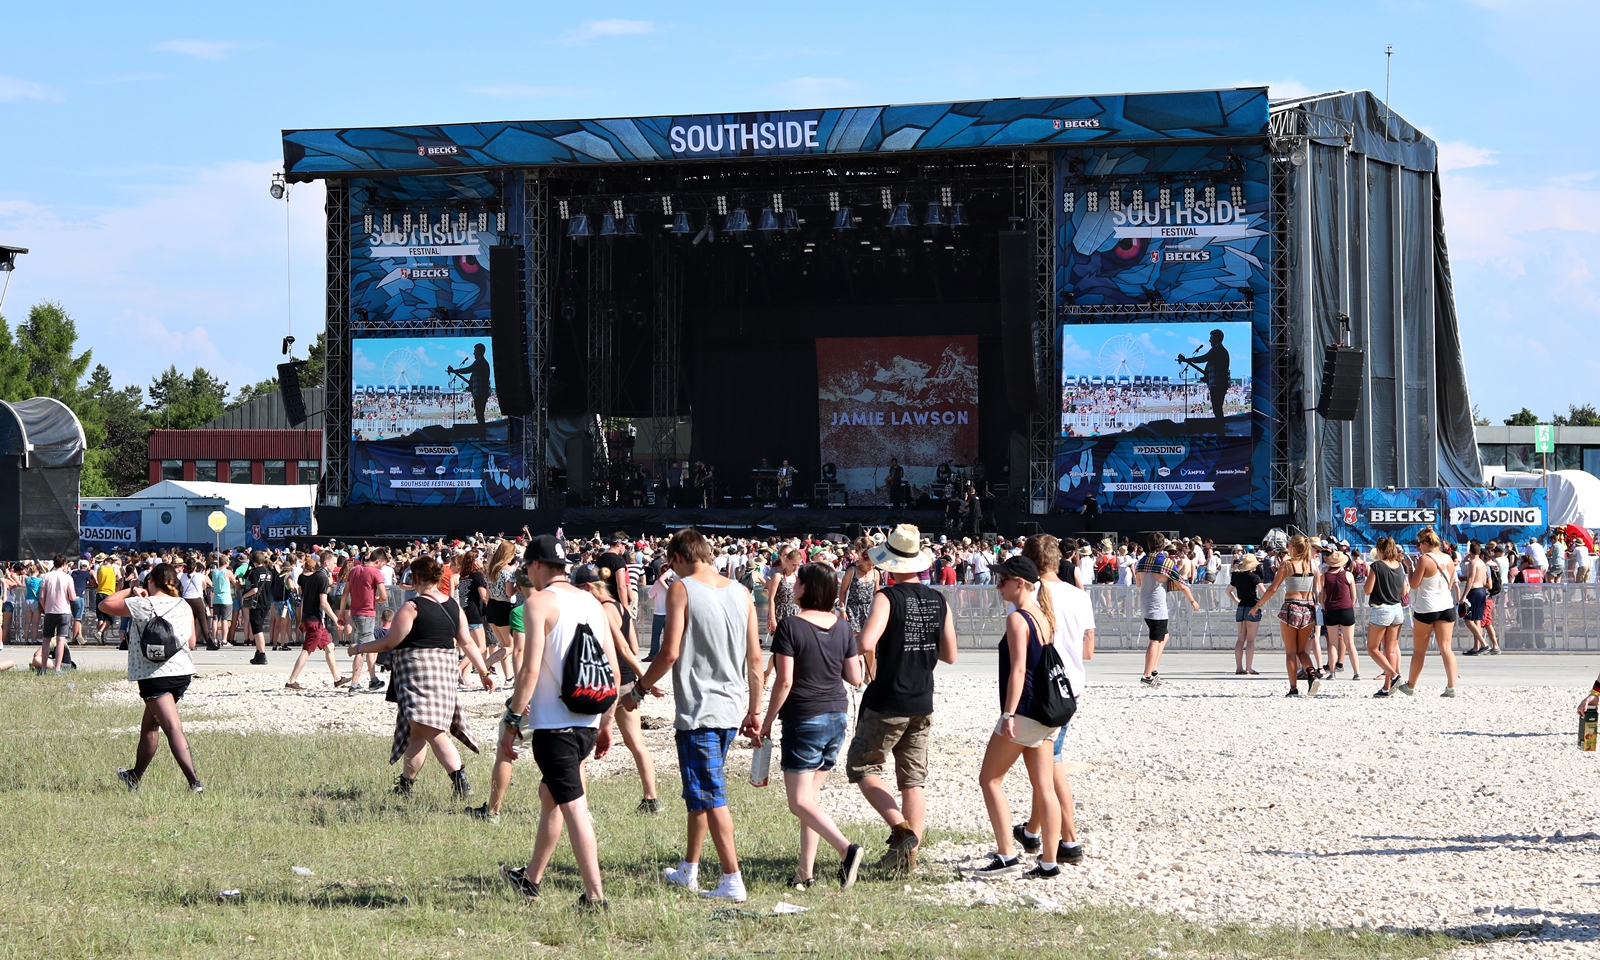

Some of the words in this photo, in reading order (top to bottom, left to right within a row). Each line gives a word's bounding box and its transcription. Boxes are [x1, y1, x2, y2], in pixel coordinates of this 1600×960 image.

[1065, 119, 1099, 128] BECK'S
[670, 120, 819, 153] SOUTHSIDE
[428, 146, 457, 154] BECK'S
[1112, 200, 1247, 225] SOUTHSIDE
[369, 221, 479, 245] SOUTHSIDE
[1161, 228, 1198, 236] FESTIVAL
[409, 247, 440, 255] FESTIVAL
[1165, 250, 1210, 261] BECK'S
[412, 268, 449, 278] BECK'S
[831, 412, 885, 426] JAMIE
[891, 411, 969, 425] LAWSON
[1371, 508, 1435, 522] BECK'S
[1470, 510, 1535, 523] DASDING
[85, 528, 131, 540] DASDING
[268, 525, 307, 537] BECK'S
